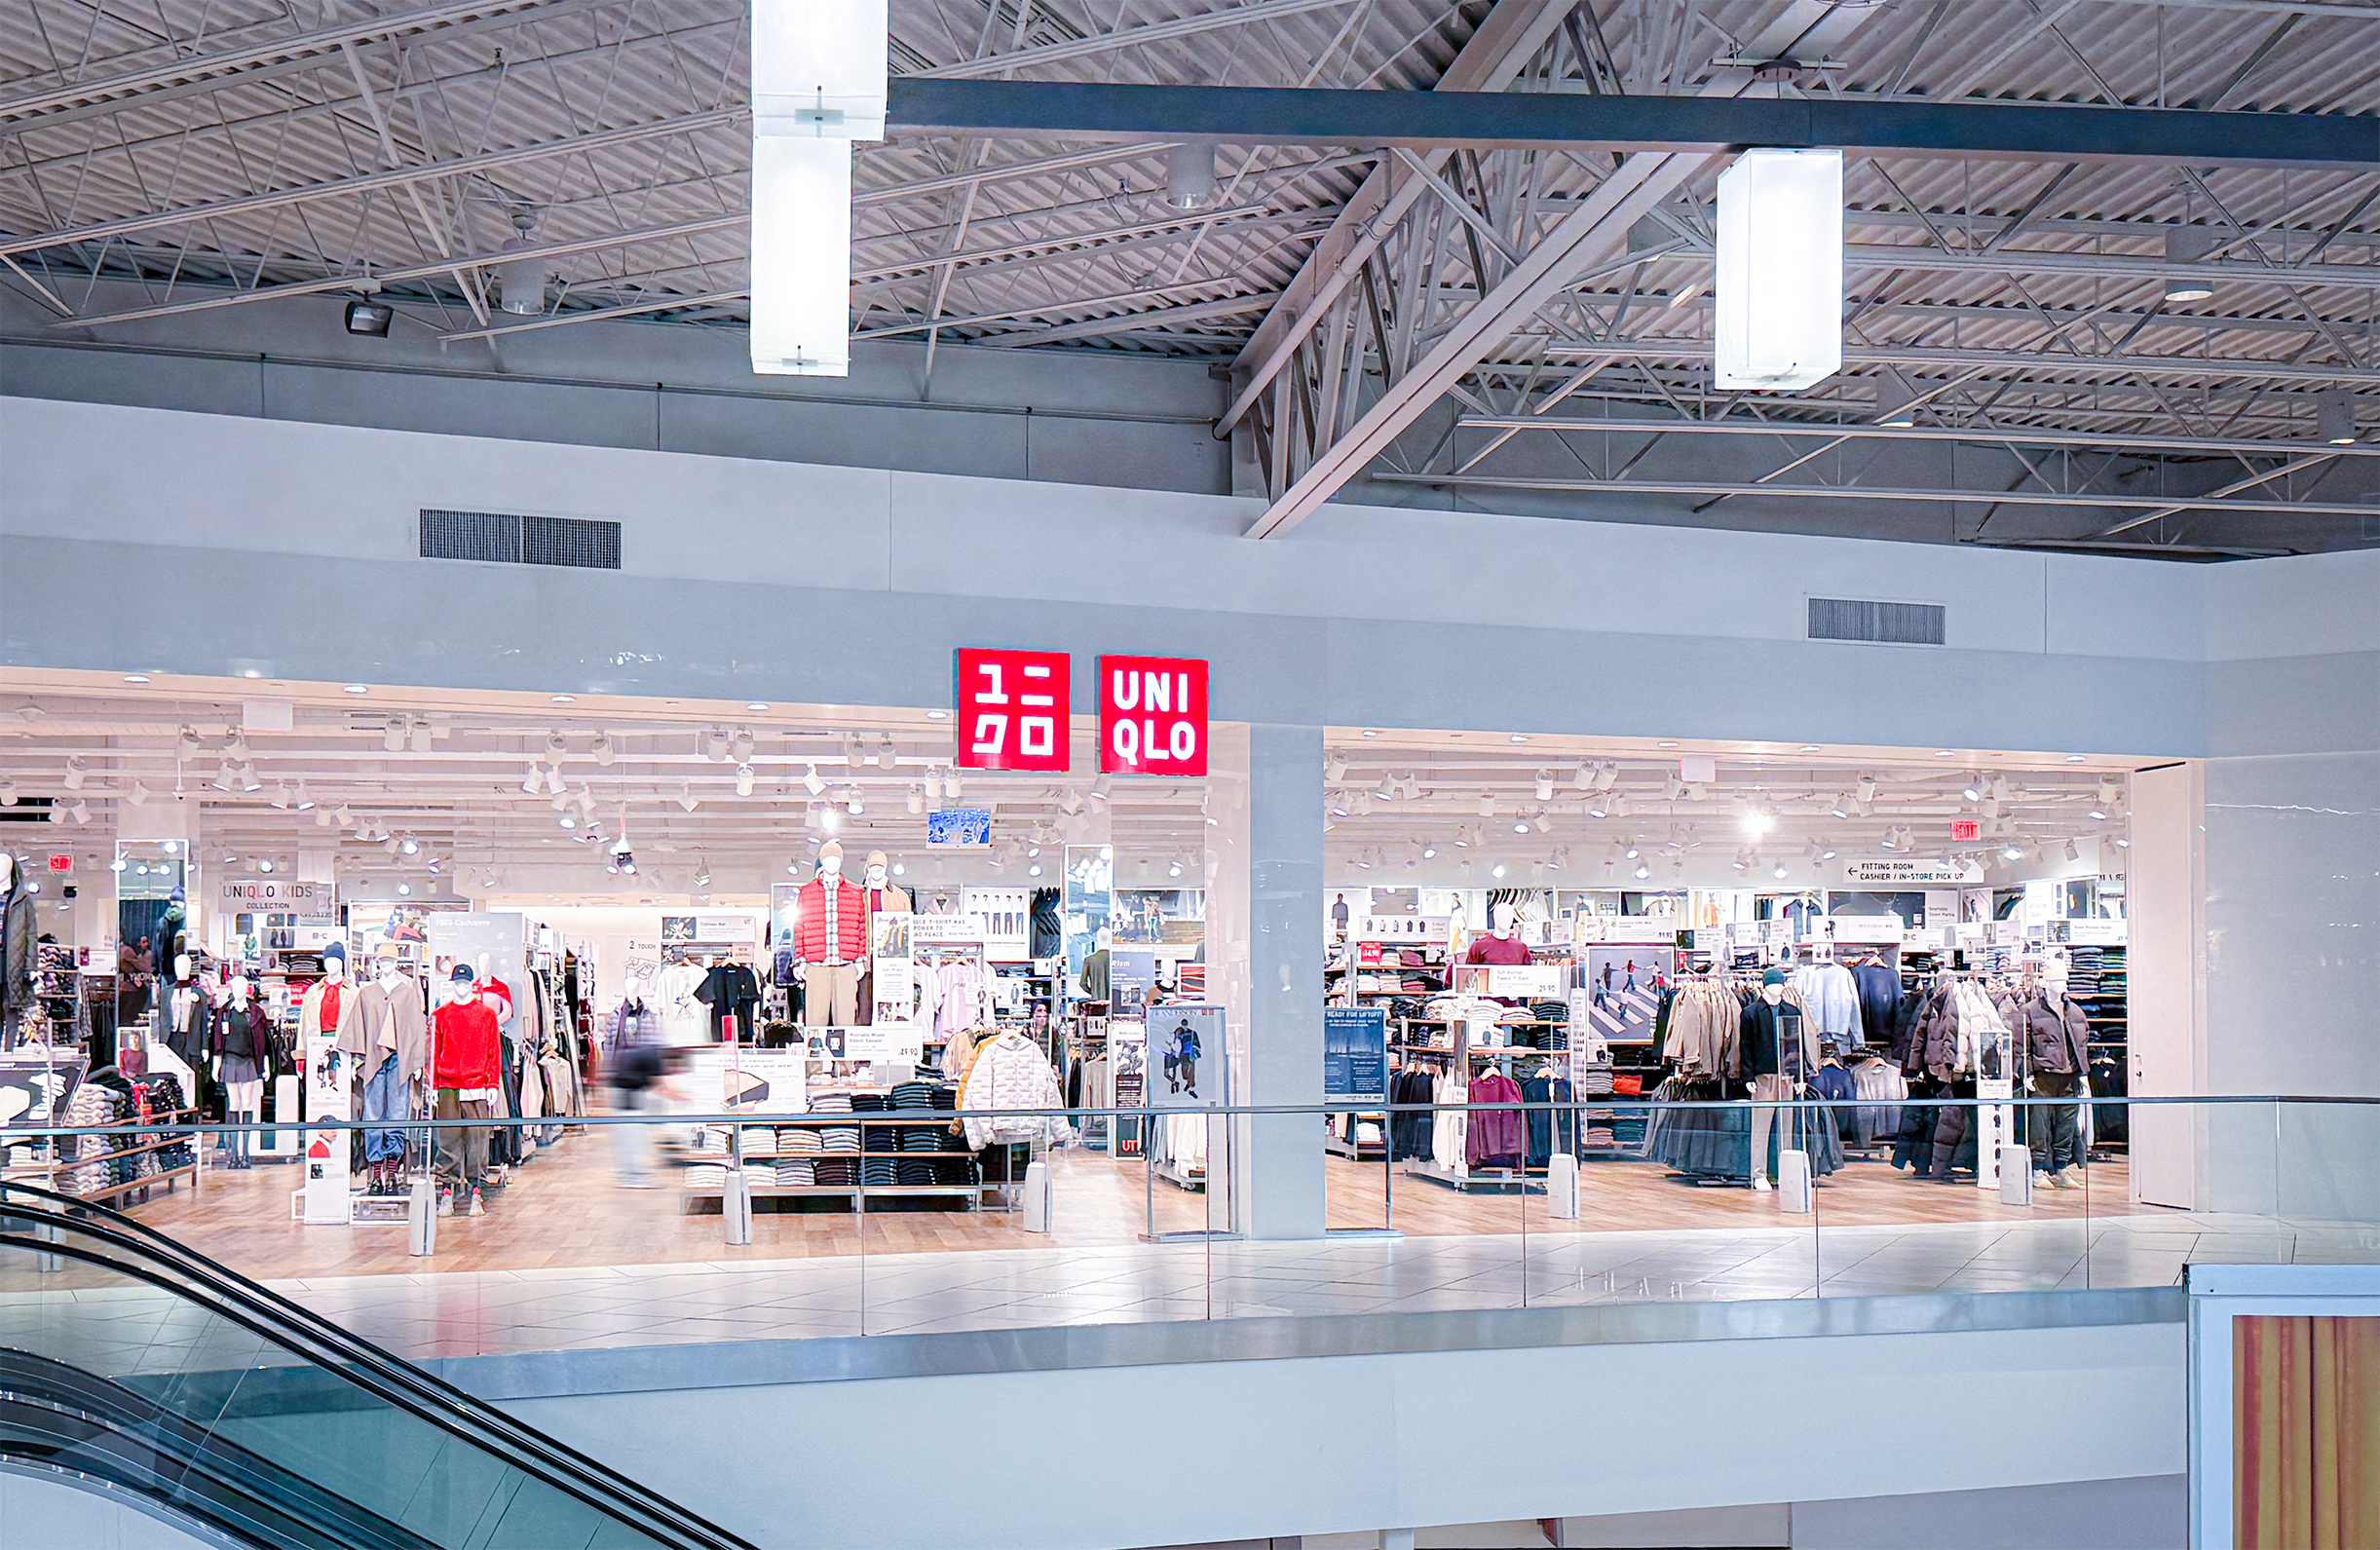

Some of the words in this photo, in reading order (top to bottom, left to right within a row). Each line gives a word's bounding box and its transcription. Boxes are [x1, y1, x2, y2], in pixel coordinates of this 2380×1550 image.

[1113, 669, 1189, 713] UNI
[1113, 718, 1196, 766] QLO
[223, 886, 275, 899] UNIQLO
[282, 886, 313, 898] KIDS
[629, 940, 635, 949] 2
[1121, 1139, 1138, 1152] UT
